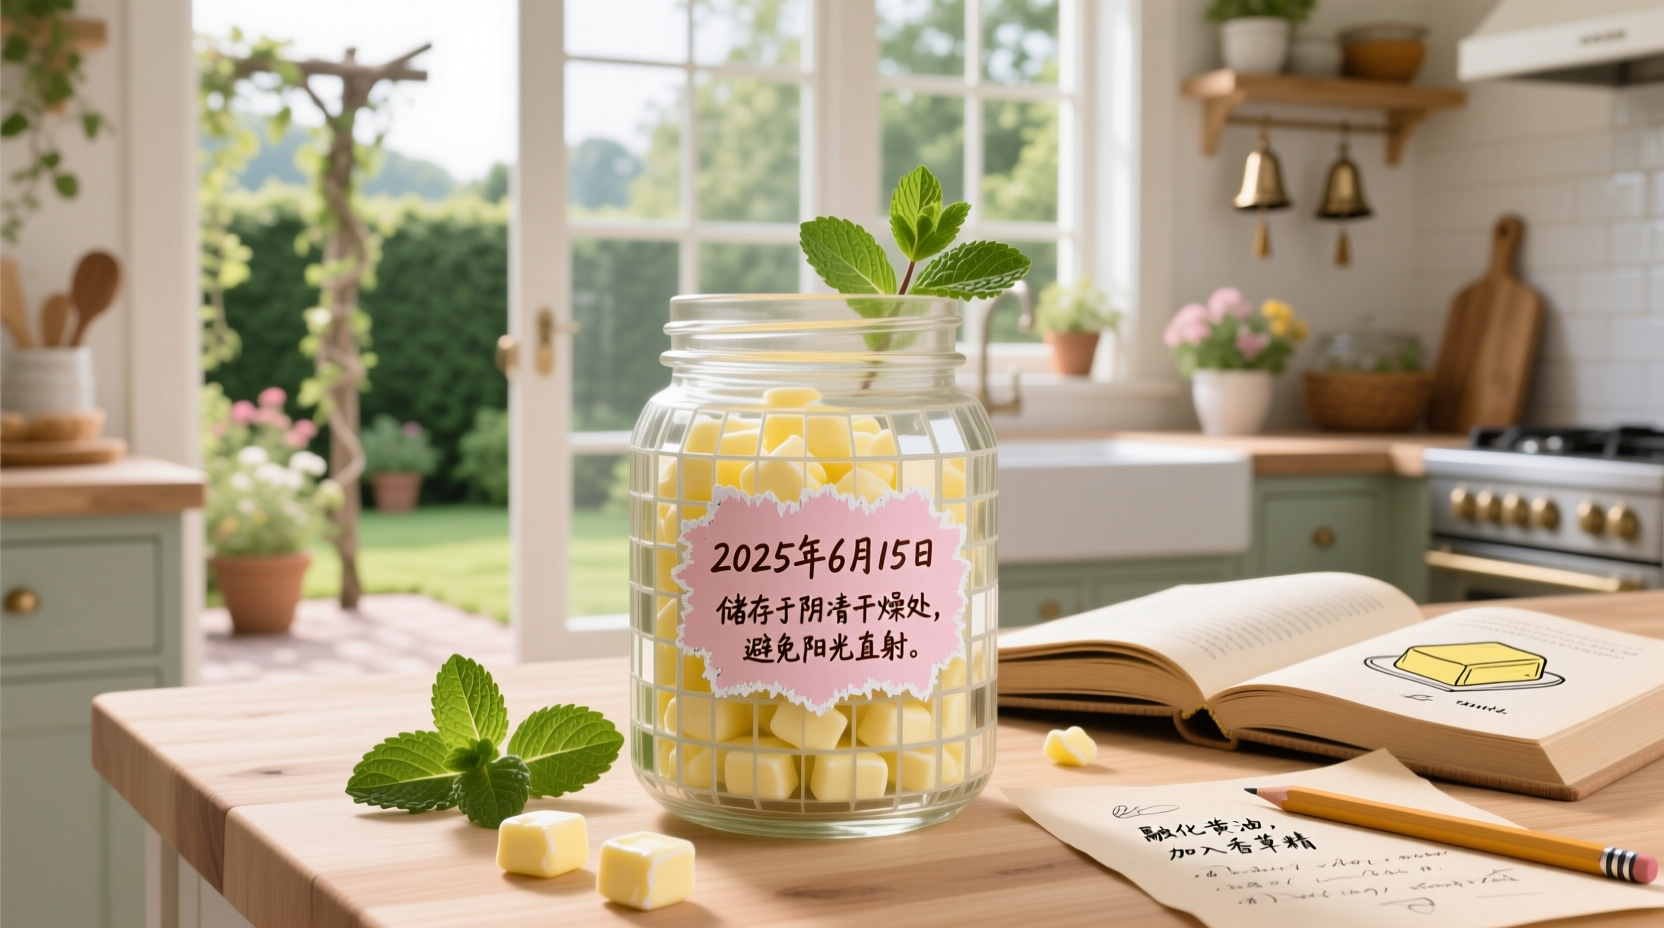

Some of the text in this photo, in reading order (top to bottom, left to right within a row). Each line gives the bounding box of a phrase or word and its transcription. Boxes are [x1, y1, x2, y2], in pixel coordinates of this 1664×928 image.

[710, 534, 933, 580] 2025年6月15日
[743, 630, 919, 664] 避免阳光直射。
[1168, 831, 1317, 861] 加入香草精
